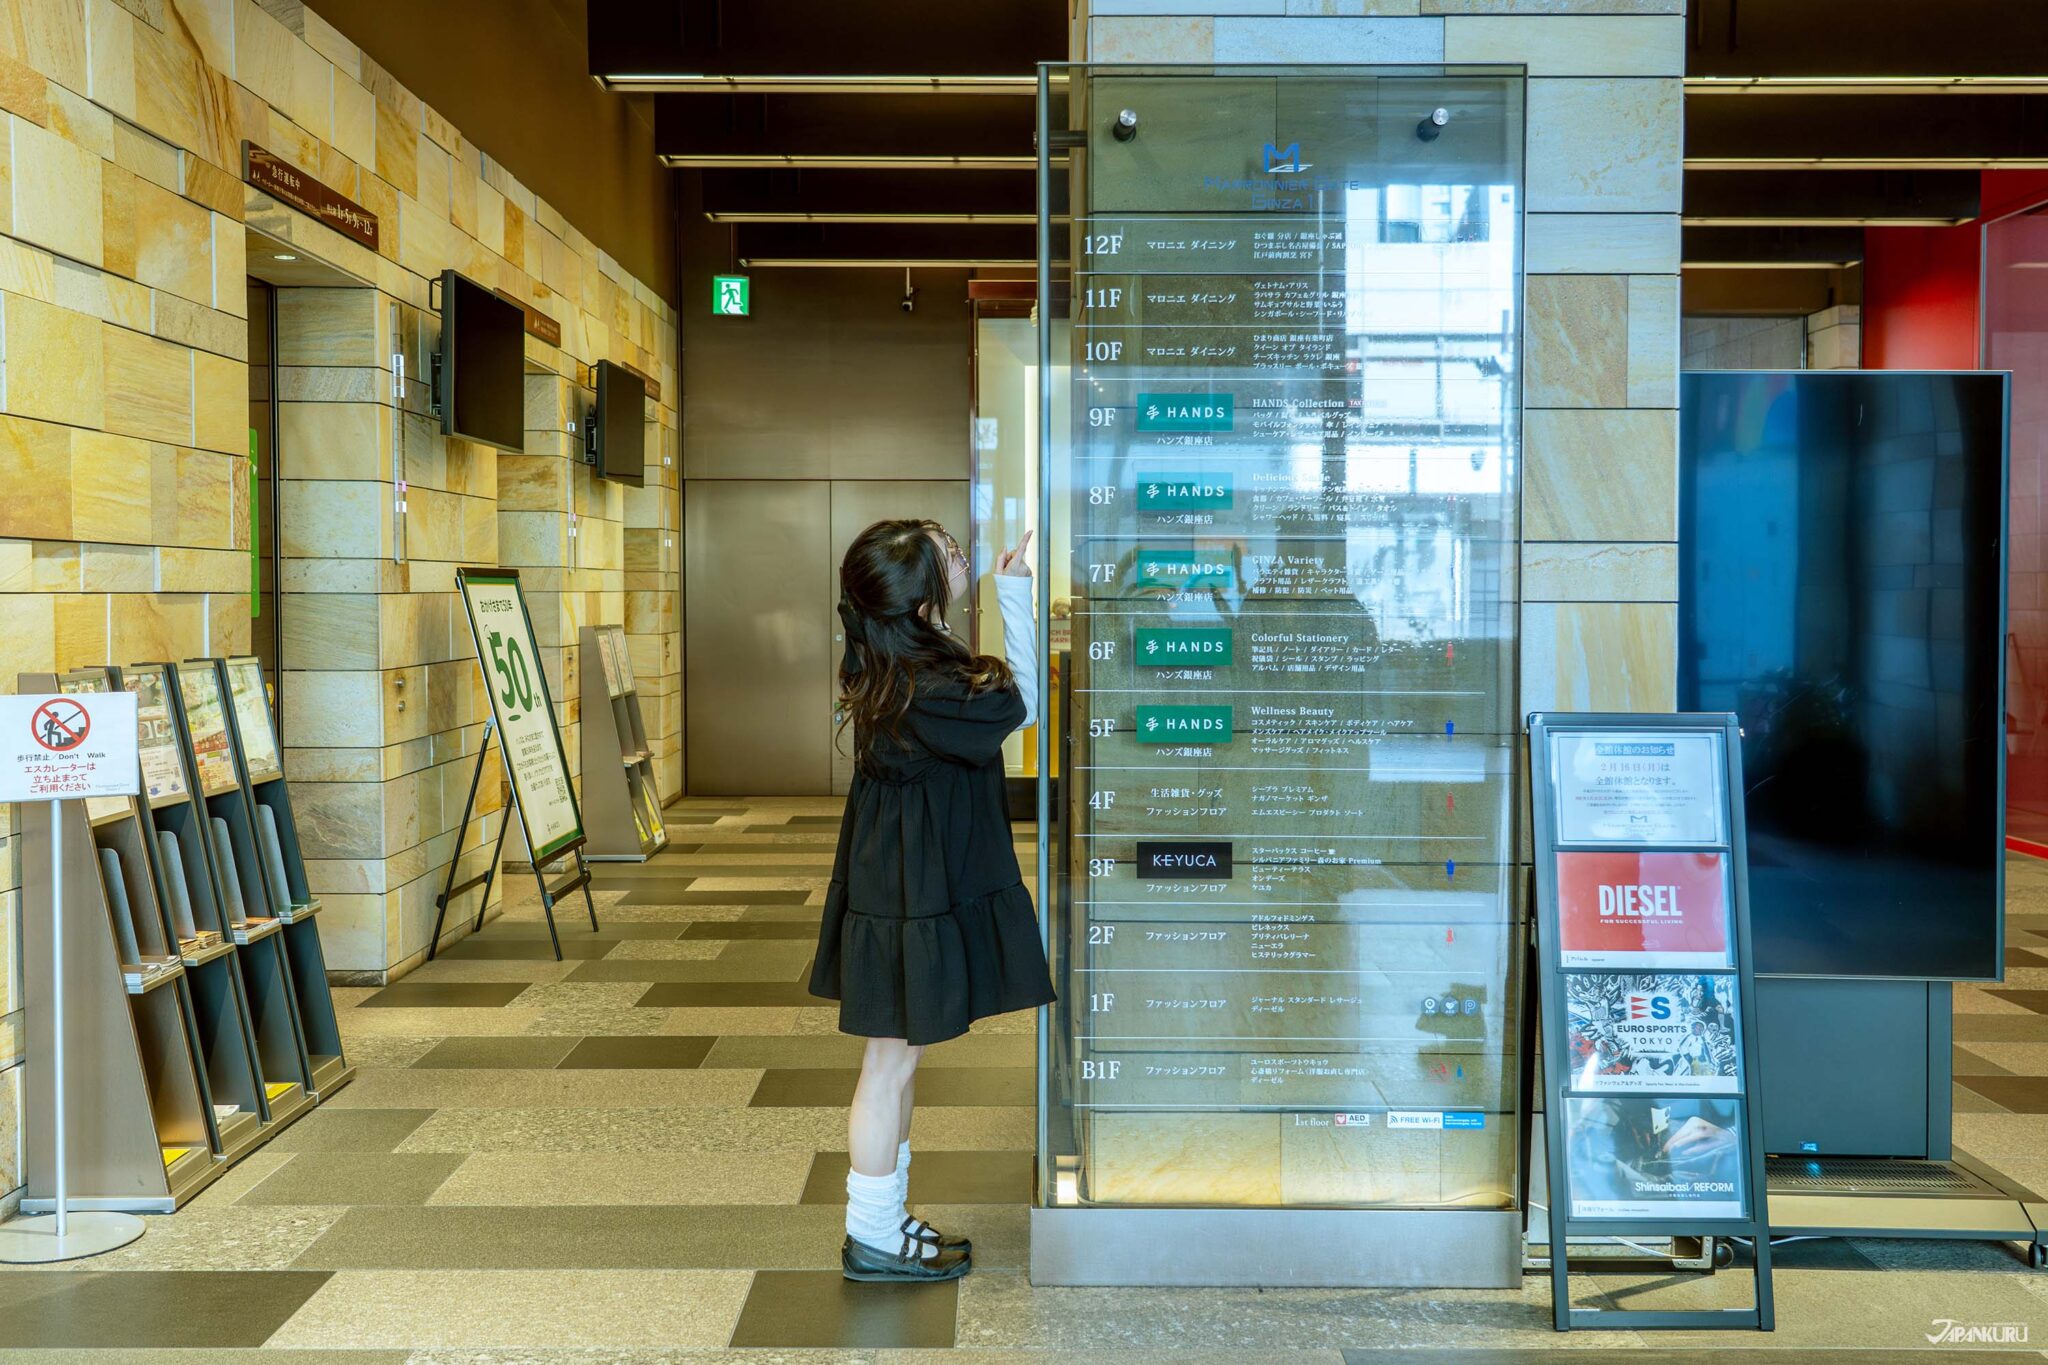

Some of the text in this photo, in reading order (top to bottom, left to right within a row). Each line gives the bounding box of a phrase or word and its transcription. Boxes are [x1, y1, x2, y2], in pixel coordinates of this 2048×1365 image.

[1084, 235, 1122, 254] 12F
[1146, 240, 1236, 250] マロニエ ダイニング
[1085, 288, 1122, 308] 11F
[1146, 294, 1236, 304] マロニエ ダイニング
[1084, 342, 1122, 360] 10F
[1146, 346, 1236, 357] マロニエ ダイニング
[1252, 399, 1344, 408] HANDS Collection
[1089, 407, 1116, 427] 9F
[1167, 407, 1224, 418] HANDS
[1156, 436, 1212, 446] ハンズ銀座店
[1089, 486, 1116, 505] 8F
[1167, 486, 1224, 496] HANDS
[1156, 514, 1212, 524] ハンズ銀座店
[1288, 556, 1325, 566] Variety
[1089, 564, 1116, 583] 7F
[1167, 564, 1224, 575] HANDS
[1156, 592, 1212, 602] ハンズ銀座店
[1251, 633, 1348, 645] Colorful Stationery
[1088, 642, 1115, 660] 6F
[1166, 642, 1223, 653] HANDS
[487, 631, 533, 713] 50
[1156, 670, 1212, 681] ハンズ銀座店
[1251, 706, 1334, 718] Wellness Beauty
[1088, 719, 1114, 738] 5F
[1166, 719, 1223, 730] HANDS
[87, 752, 106, 760] Walk
[1156, 747, 1212, 758] ハンズ銀座店
[24, 762, 97, 774] エスカレーターは
[33, 773, 88, 784] 立ち止まって
[30, 782, 91, 794] ご利用ください
[1150, 788, 1224, 798] 生活雑貨・グッズ
[1088, 791, 1114, 810] 4F
[1146, 806, 1227, 816] ファッションフロア
[1153, 854, 1216, 868] KEYUCA
[1348, 856, 1382, 864] Premium
[1088, 858, 1114, 878] 3F
[1146, 883, 1227, 894] ファッションフロア
[1598, 884, 1683, 917] DIESEL
[1088, 926, 1114, 945] 2F
[1145, 931, 1226, 942] ファッションフロア
[1090, 994, 1114, 1012] 1F
[1145, 999, 1226, 1010] ファッションフロア
[1616, 1024, 1688, 1034] EURO SPORTS
[1633, 1037, 1673, 1045] TOKYO
[1080, 1060, 1120, 1080] B1F
[1145, 1066, 1226, 1076] ファッションフロア
[1400, 1116, 1419, 1124] FREE
